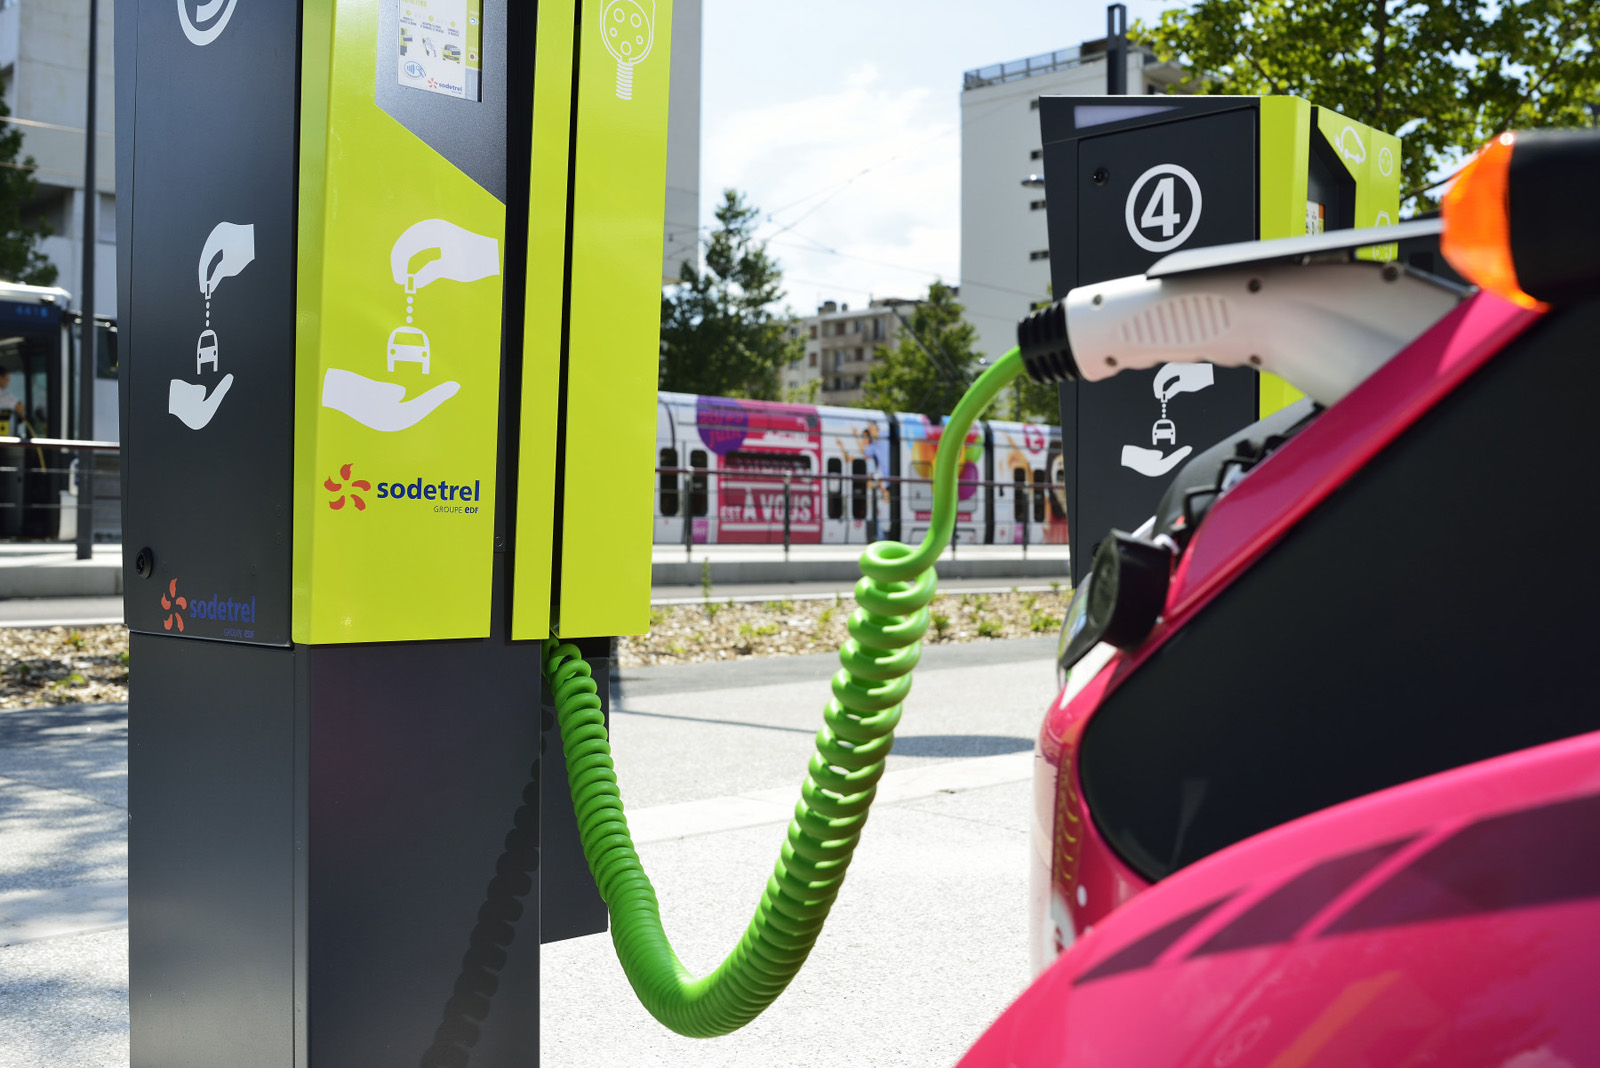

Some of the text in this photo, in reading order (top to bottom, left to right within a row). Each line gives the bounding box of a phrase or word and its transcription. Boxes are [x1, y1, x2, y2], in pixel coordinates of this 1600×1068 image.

[1140, 176, 1181, 237] 4
[376, 477, 480, 502] sodetrel
[433, 505, 463, 514] GROUPE
[189, 593, 256, 624] sodetrel
